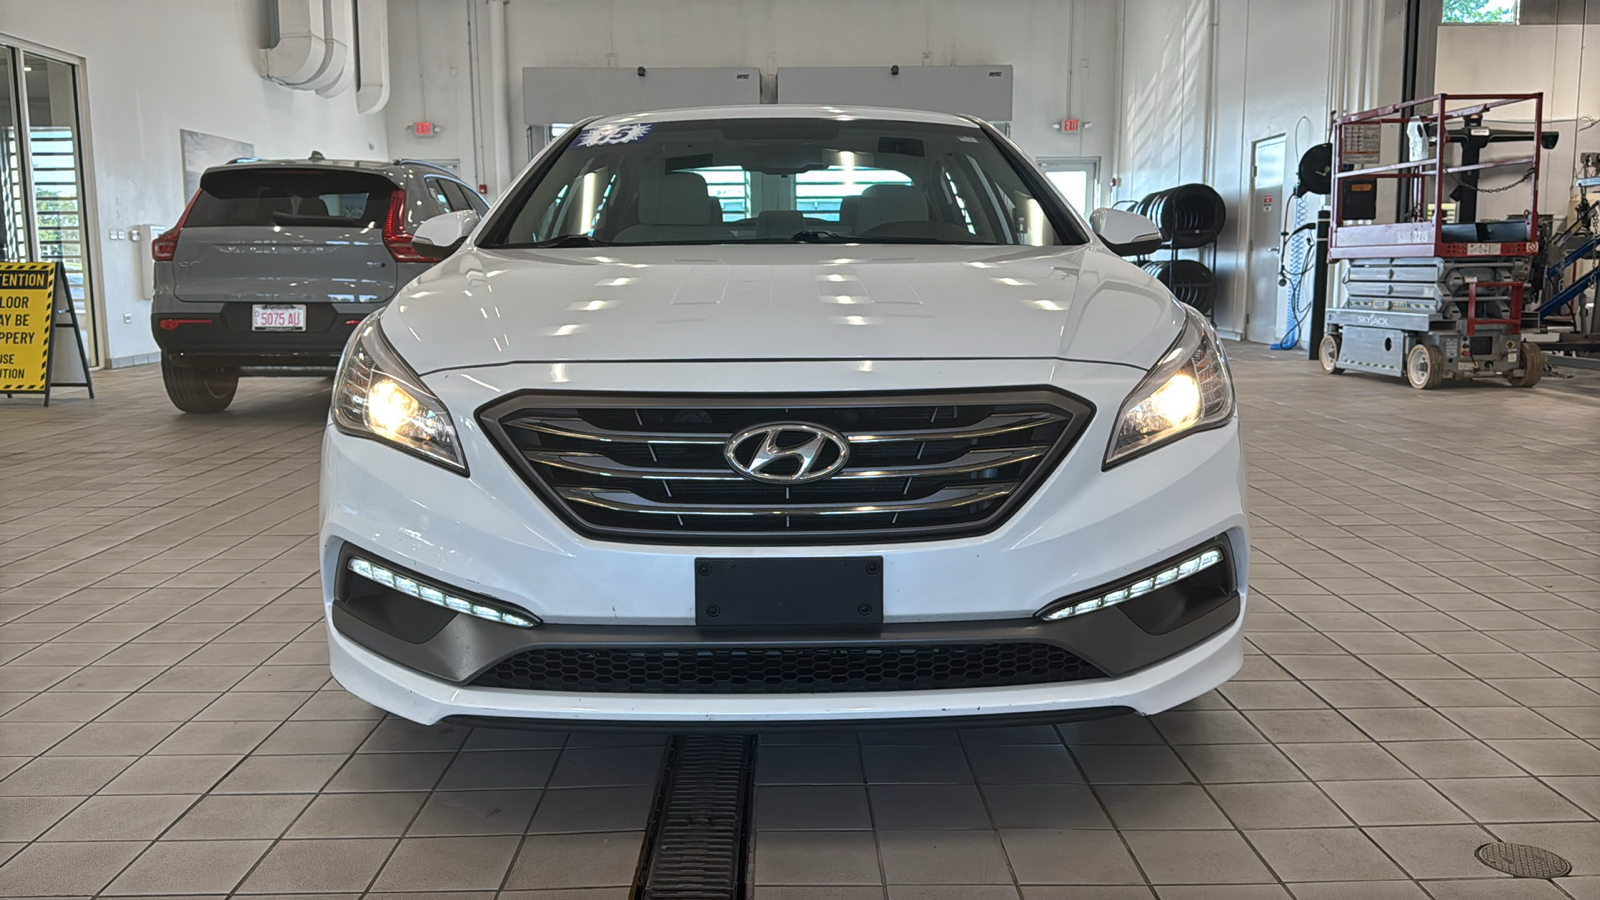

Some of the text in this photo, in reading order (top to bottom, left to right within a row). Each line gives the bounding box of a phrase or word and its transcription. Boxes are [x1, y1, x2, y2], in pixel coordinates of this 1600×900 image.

[1064, 119, 1078, 131] EXIT
[15, 314, 30, 327] BE
[261, 312, 300, 325] 5075 AU
[1357, 314, 1389, 326] SKYJACK
